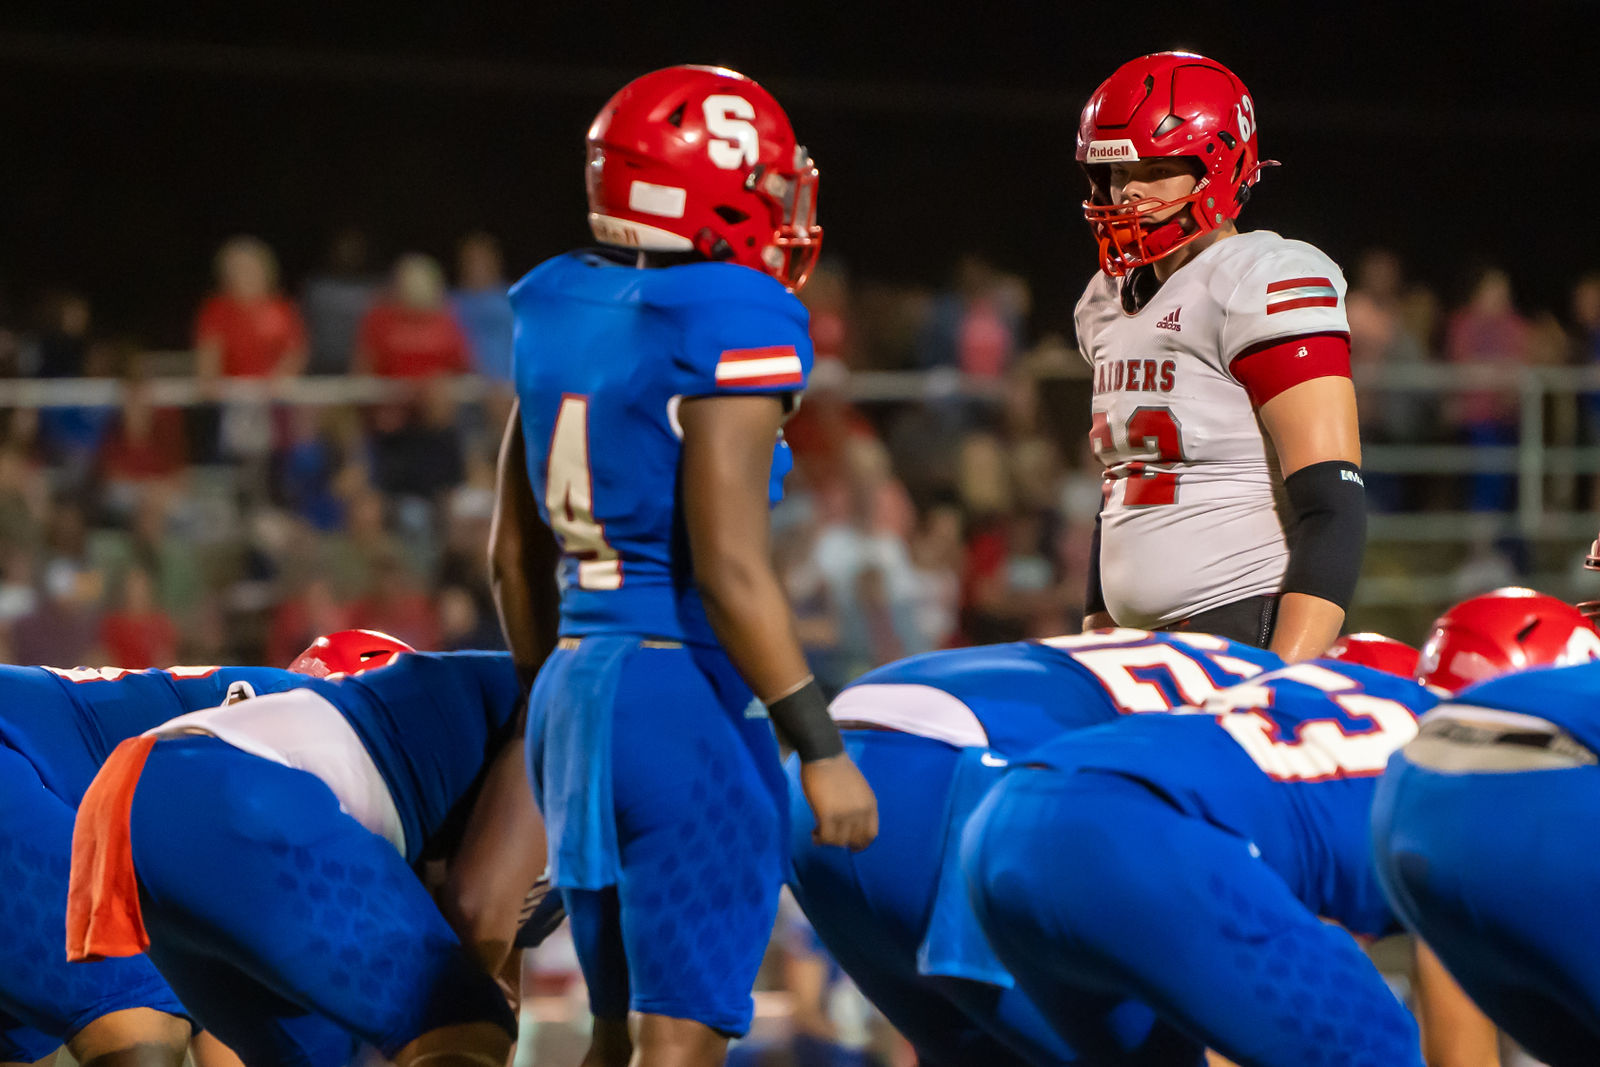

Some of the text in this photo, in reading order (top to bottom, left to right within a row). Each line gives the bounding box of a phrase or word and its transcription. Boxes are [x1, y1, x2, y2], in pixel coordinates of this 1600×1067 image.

[701, 95, 760, 170] S
[1234, 95, 1257, 142] 62
[1090, 146, 1129, 157] Riddell
[1156, 320, 1181, 331] adidas
[545, 392, 624, 590] 4
